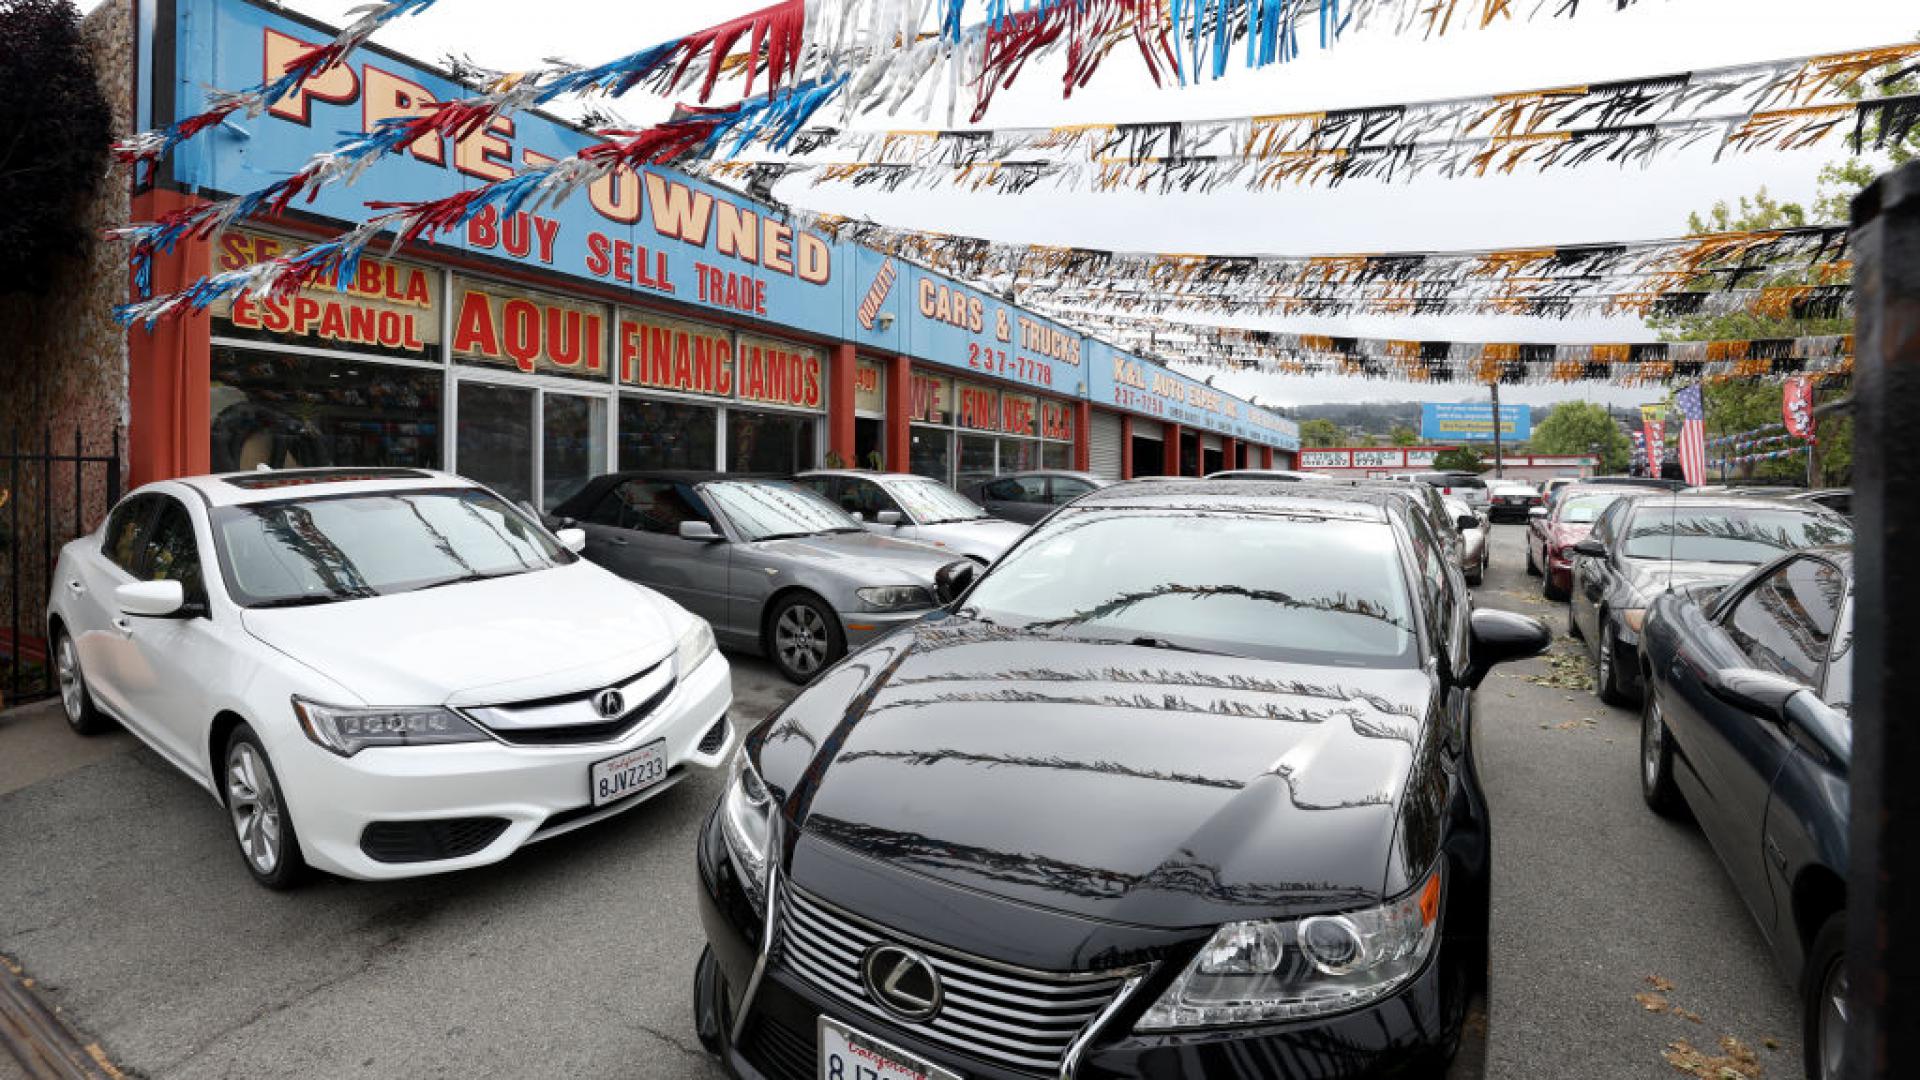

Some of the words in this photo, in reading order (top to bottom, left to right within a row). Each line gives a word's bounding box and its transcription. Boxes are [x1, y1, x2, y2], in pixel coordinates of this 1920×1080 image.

[467, 203, 559, 265] BUY
[586, 231, 675, 293] SELL
[694, 262, 767, 316] TRADE
[858, 258, 896, 330] QUALITY
[232, 288, 424, 350] ESPANOL
[453, 290, 601, 372] AQUI
[919, 277, 983, 334] CARS
[996, 307, 1010, 342] &
[1019, 317, 1081, 366] TRUCKS
[910, 374, 942, 423] WE
[968, 342, 1052, 385] 237-7778
